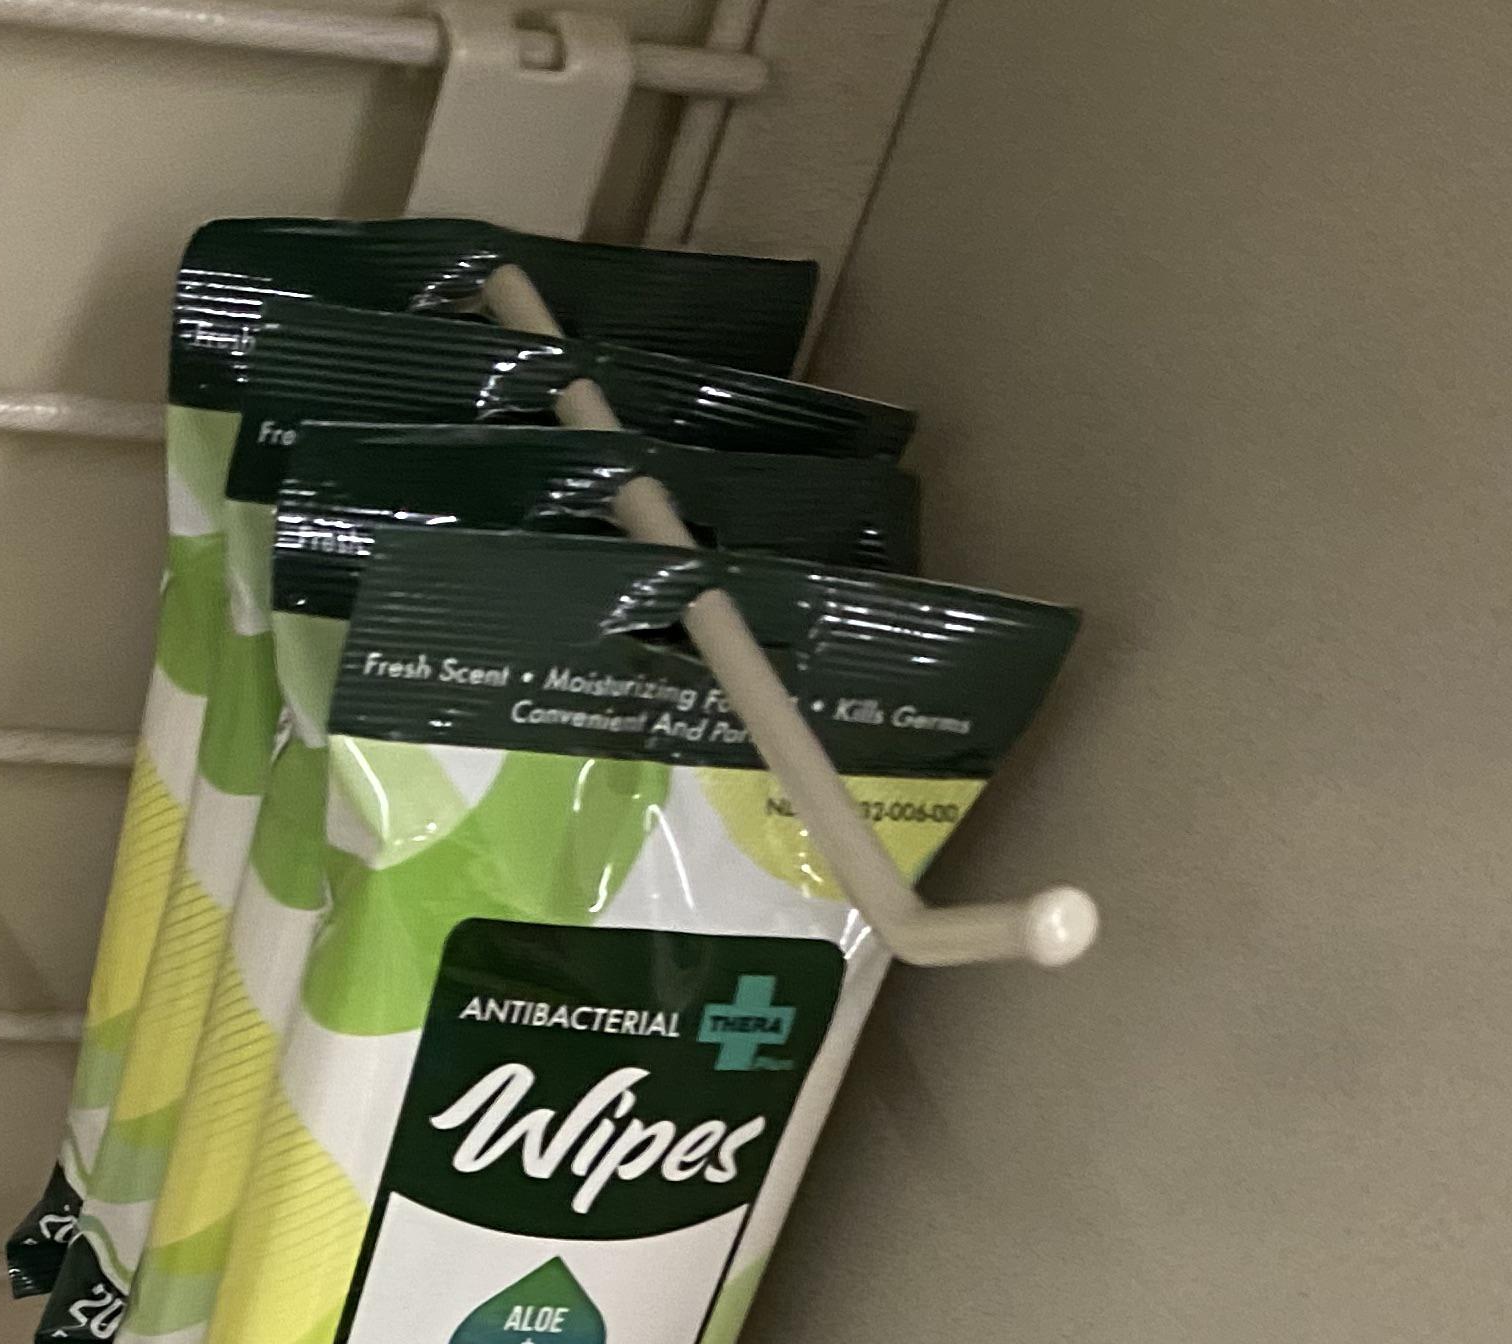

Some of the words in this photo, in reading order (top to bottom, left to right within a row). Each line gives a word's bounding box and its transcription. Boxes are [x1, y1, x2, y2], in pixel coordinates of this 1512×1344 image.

[257, 420, 297, 446] Fre
[362, 651, 433, 681] Fresh
[439, 658, 511, 688] Scent
[543, 666, 696, 712] Moisturizing
[510, 700, 647, 734] Convenient
[651, 711, 705, 742] And
[458, 995, 680, 1038] ANTIBACTERIAL
[707, 1013, 782, 1037] THERA
[430, 1062, 766, 1215] Wipes
[503, 1305, 570, 1334] ALOE
